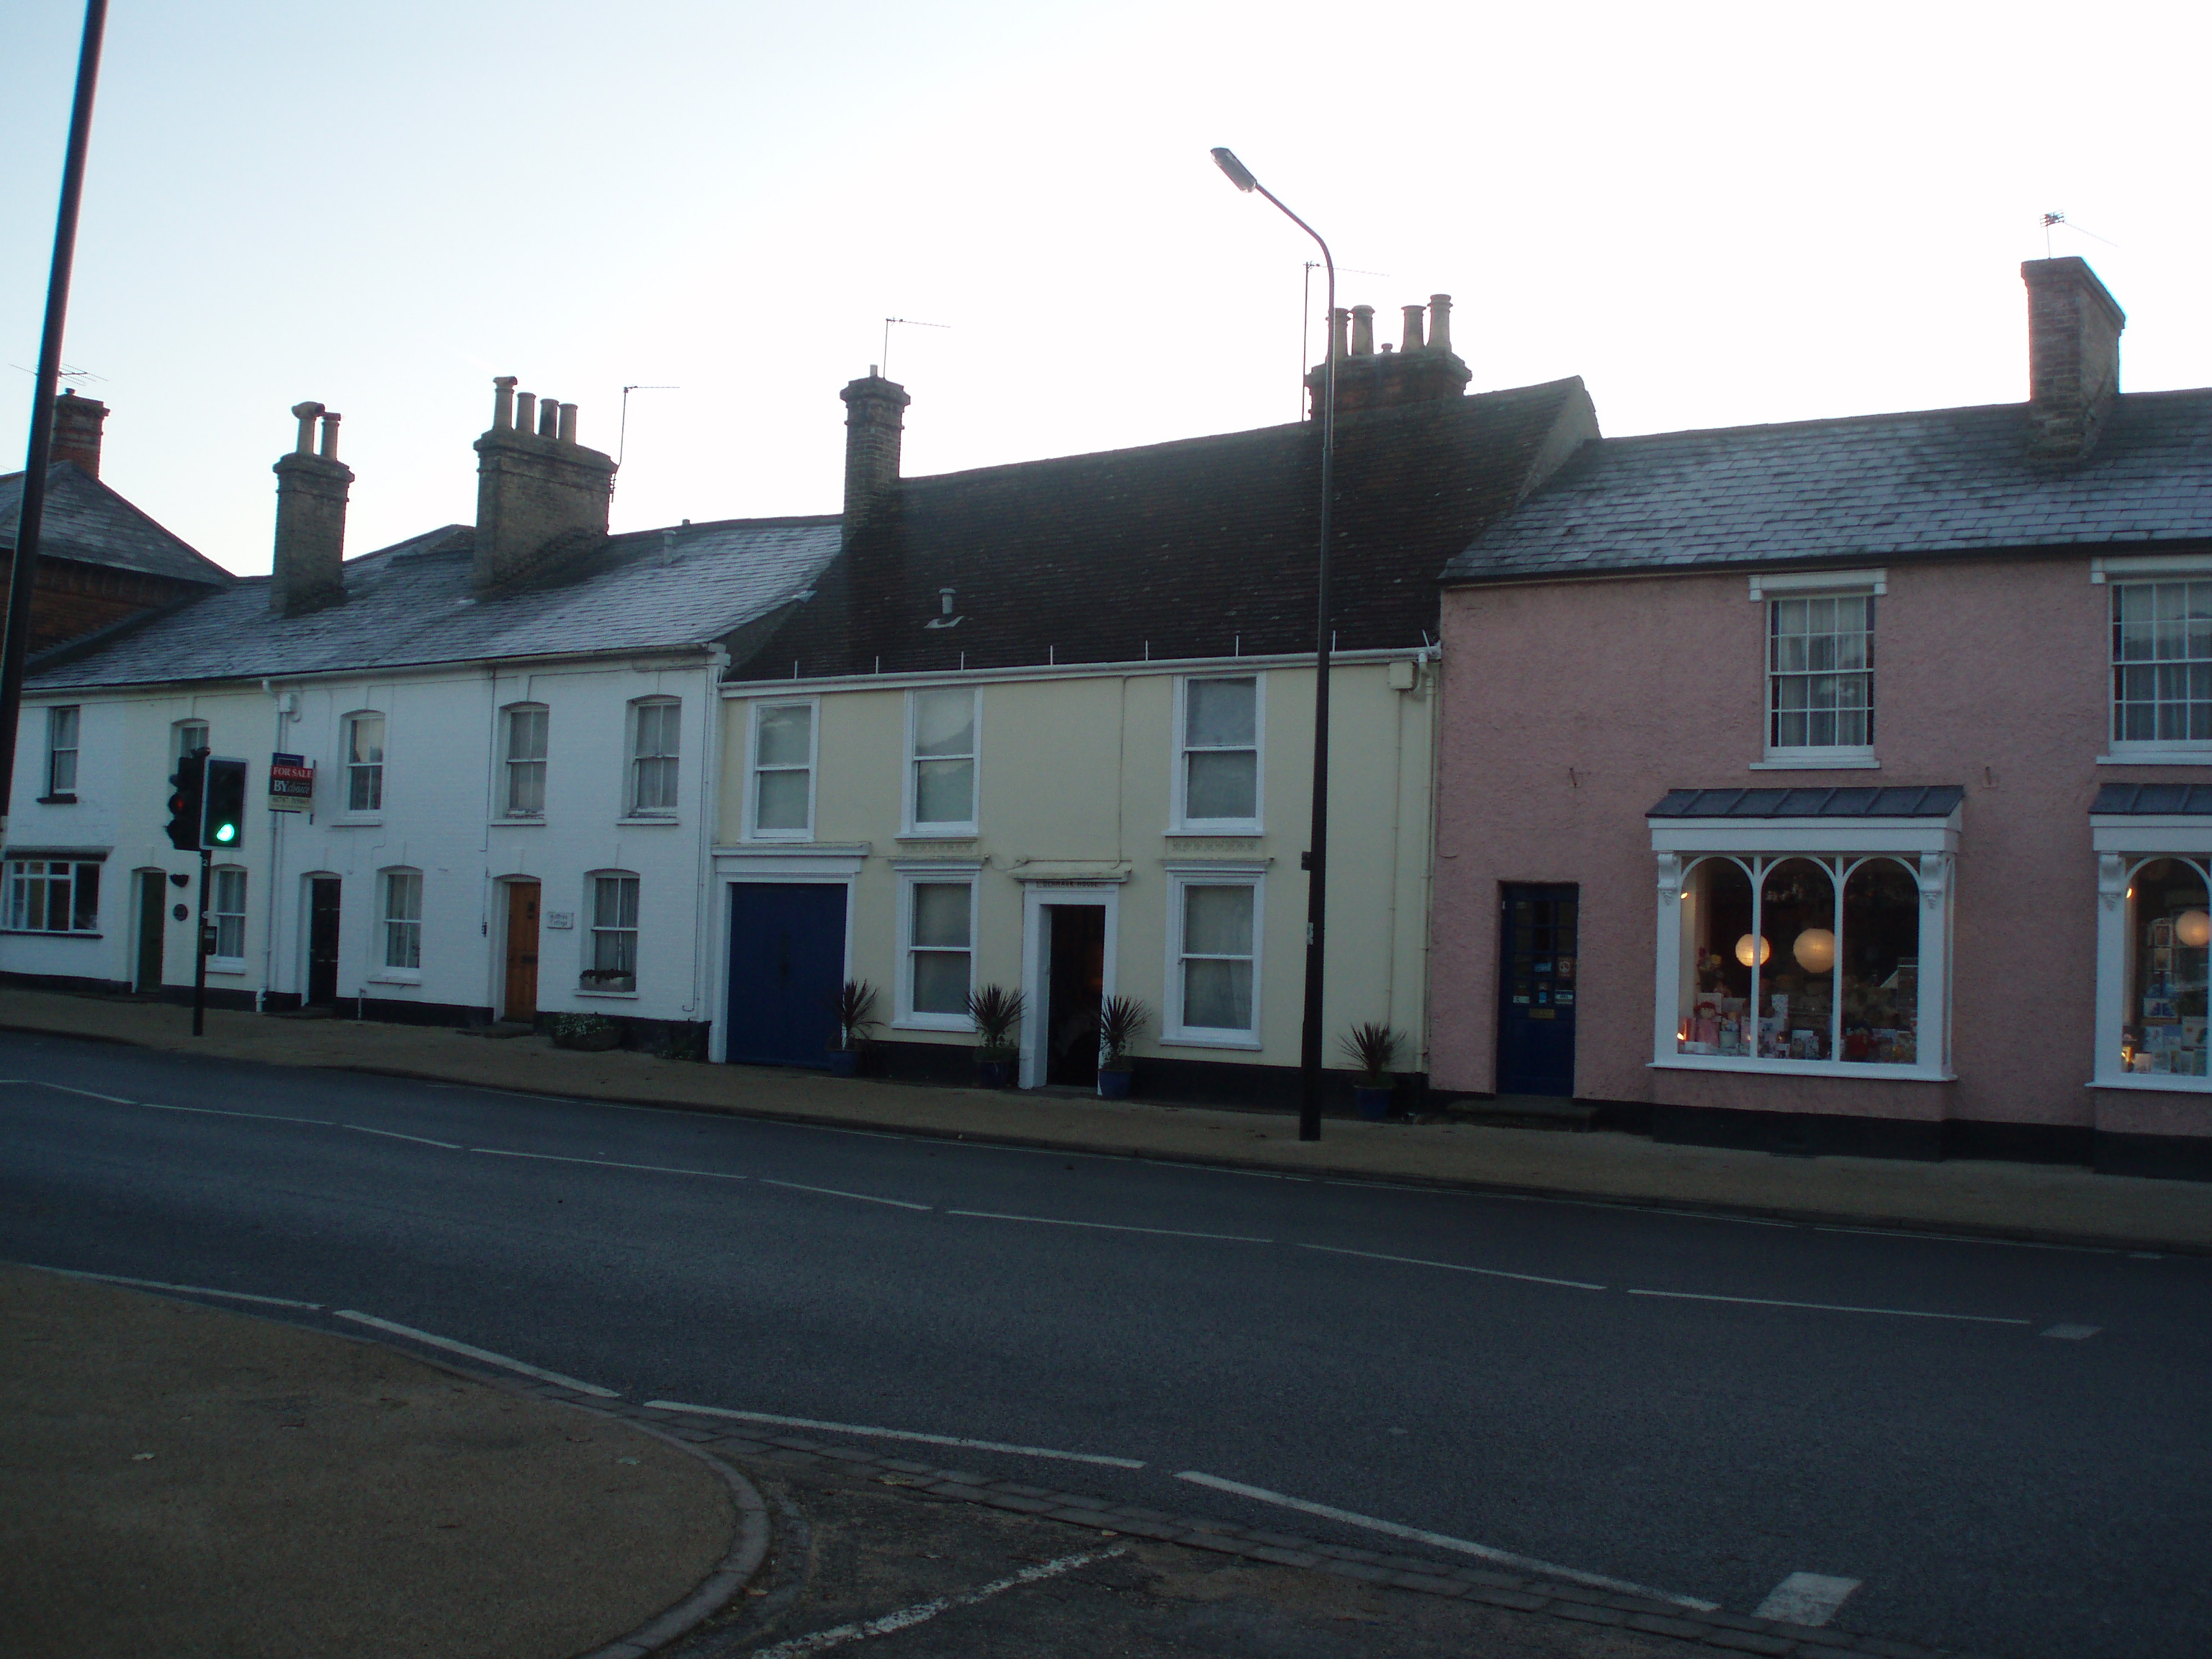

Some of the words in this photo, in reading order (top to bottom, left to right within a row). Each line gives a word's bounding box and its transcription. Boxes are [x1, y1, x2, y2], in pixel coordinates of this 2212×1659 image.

[274, 766, 290, 777] FOR
[292, 768, 313, 778] SALE
[274, 780, 287, 793] BY
